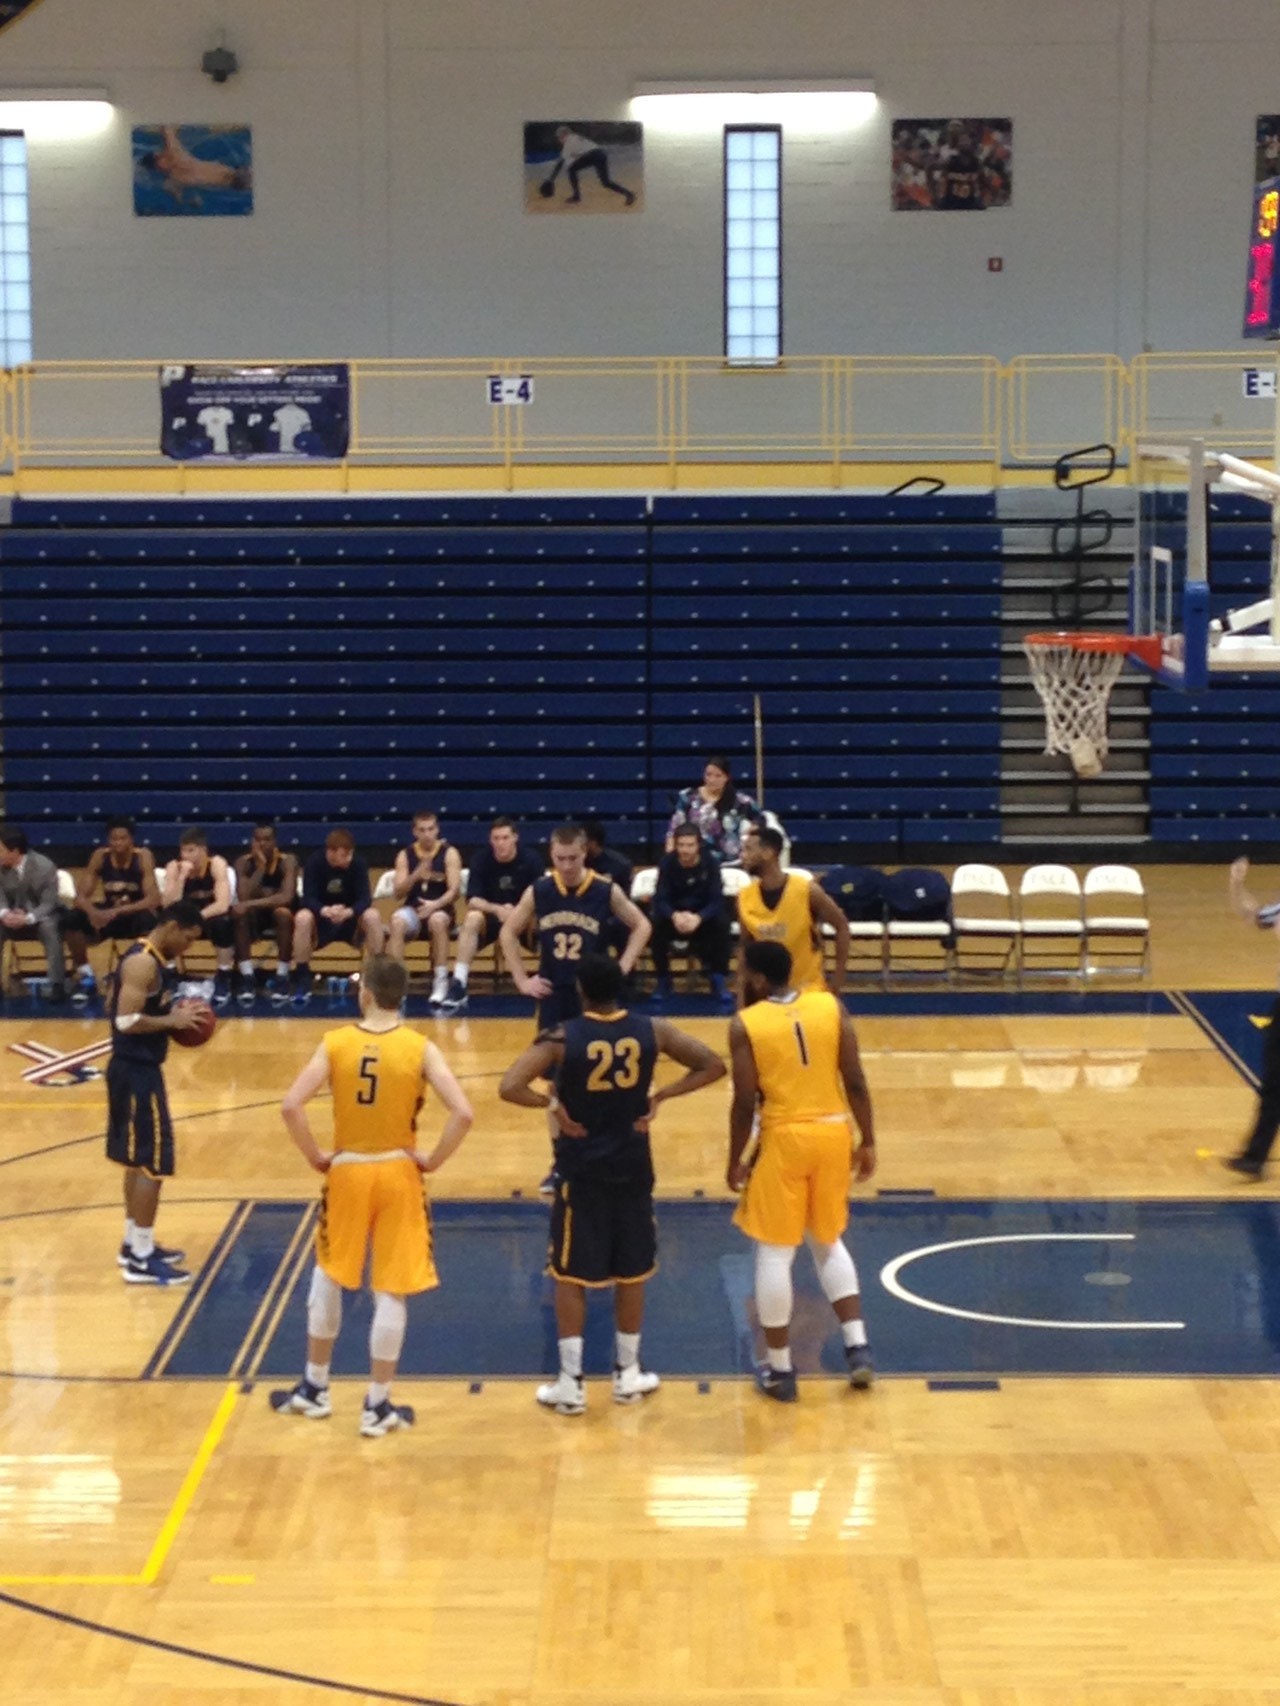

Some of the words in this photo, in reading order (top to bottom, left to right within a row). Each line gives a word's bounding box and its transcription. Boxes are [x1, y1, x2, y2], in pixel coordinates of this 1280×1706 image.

[490, 380, 530, 402] E-4
[553, 931, 583, 960] 32
[586, 1036, 641, 1091] 23
[793, 1020, 808, 1067] 1
[356, 1056, 378, 1105] 5
